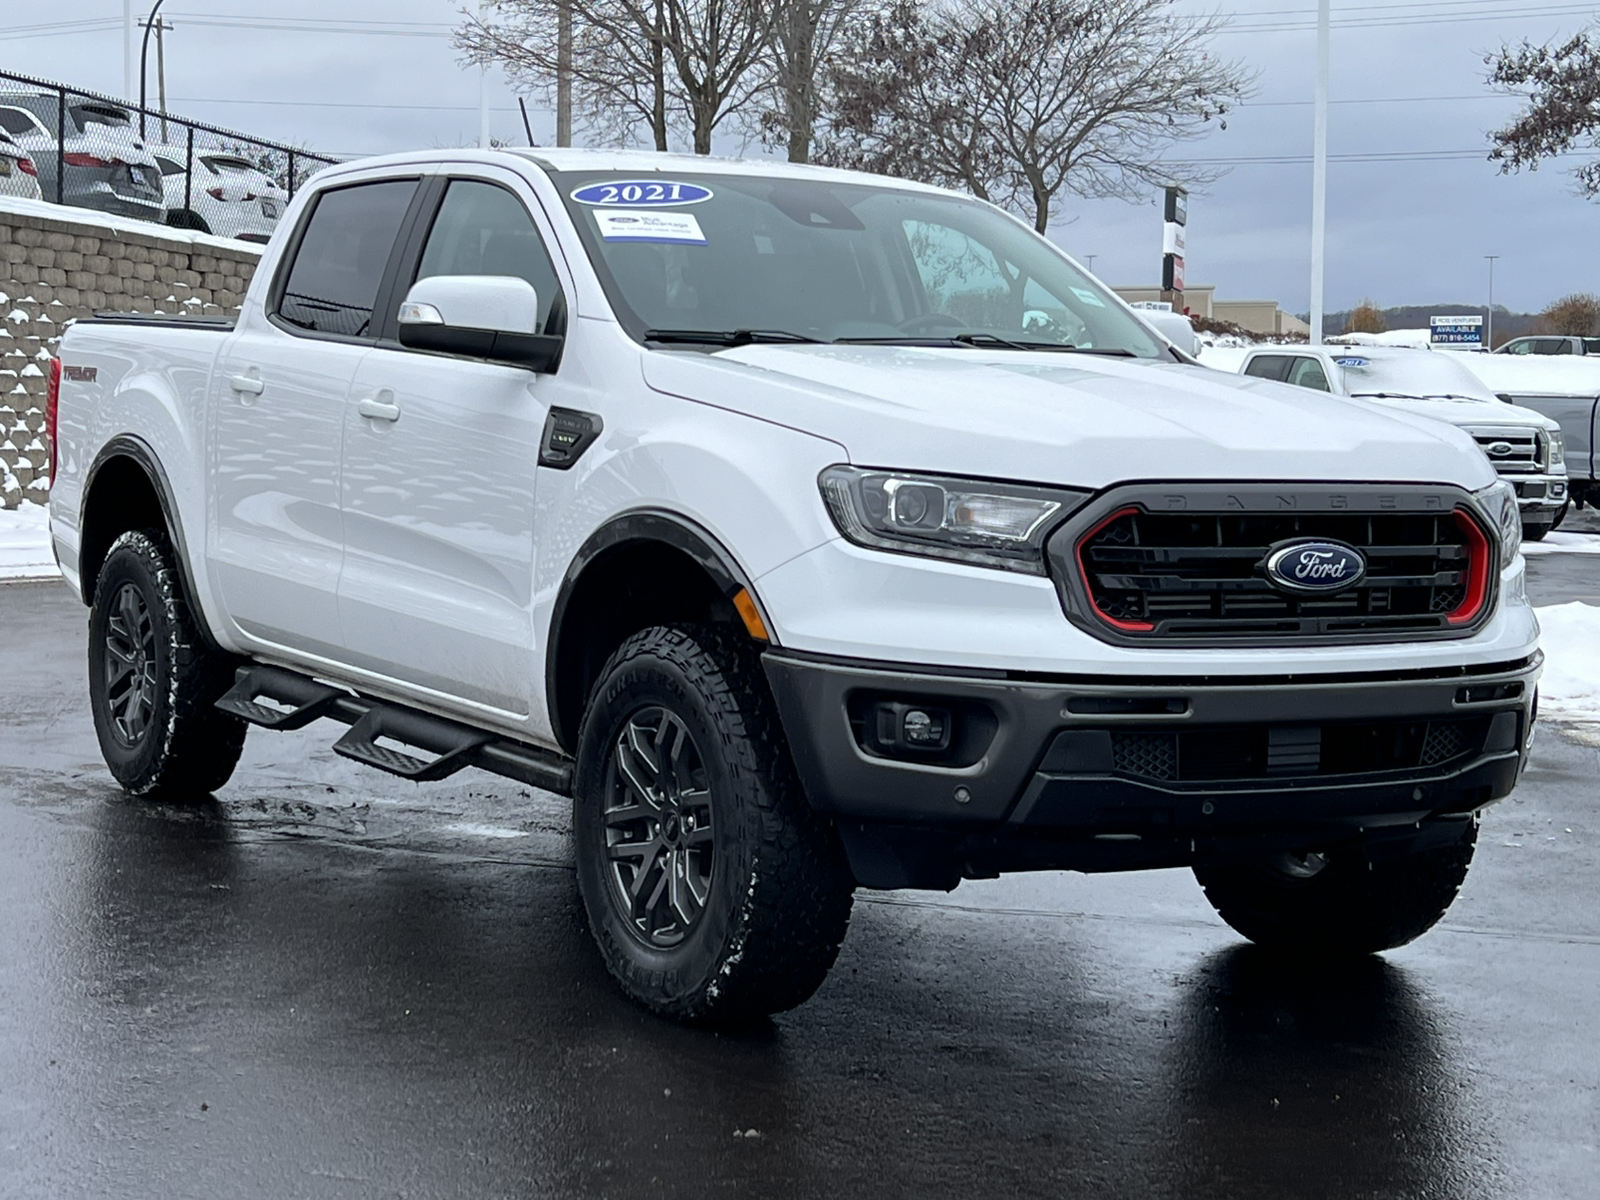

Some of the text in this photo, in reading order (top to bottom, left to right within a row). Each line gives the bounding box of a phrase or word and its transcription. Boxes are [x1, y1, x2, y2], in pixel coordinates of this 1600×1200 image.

[600, 184, 684, 203] 2021
[1436, 325, 1476, 333] AVAILABLE
[64, 365, 97, 382] TREMOR
[1162, 494, 1444, 510] RANGER
[1295, 551, 1347, 578] Ford
